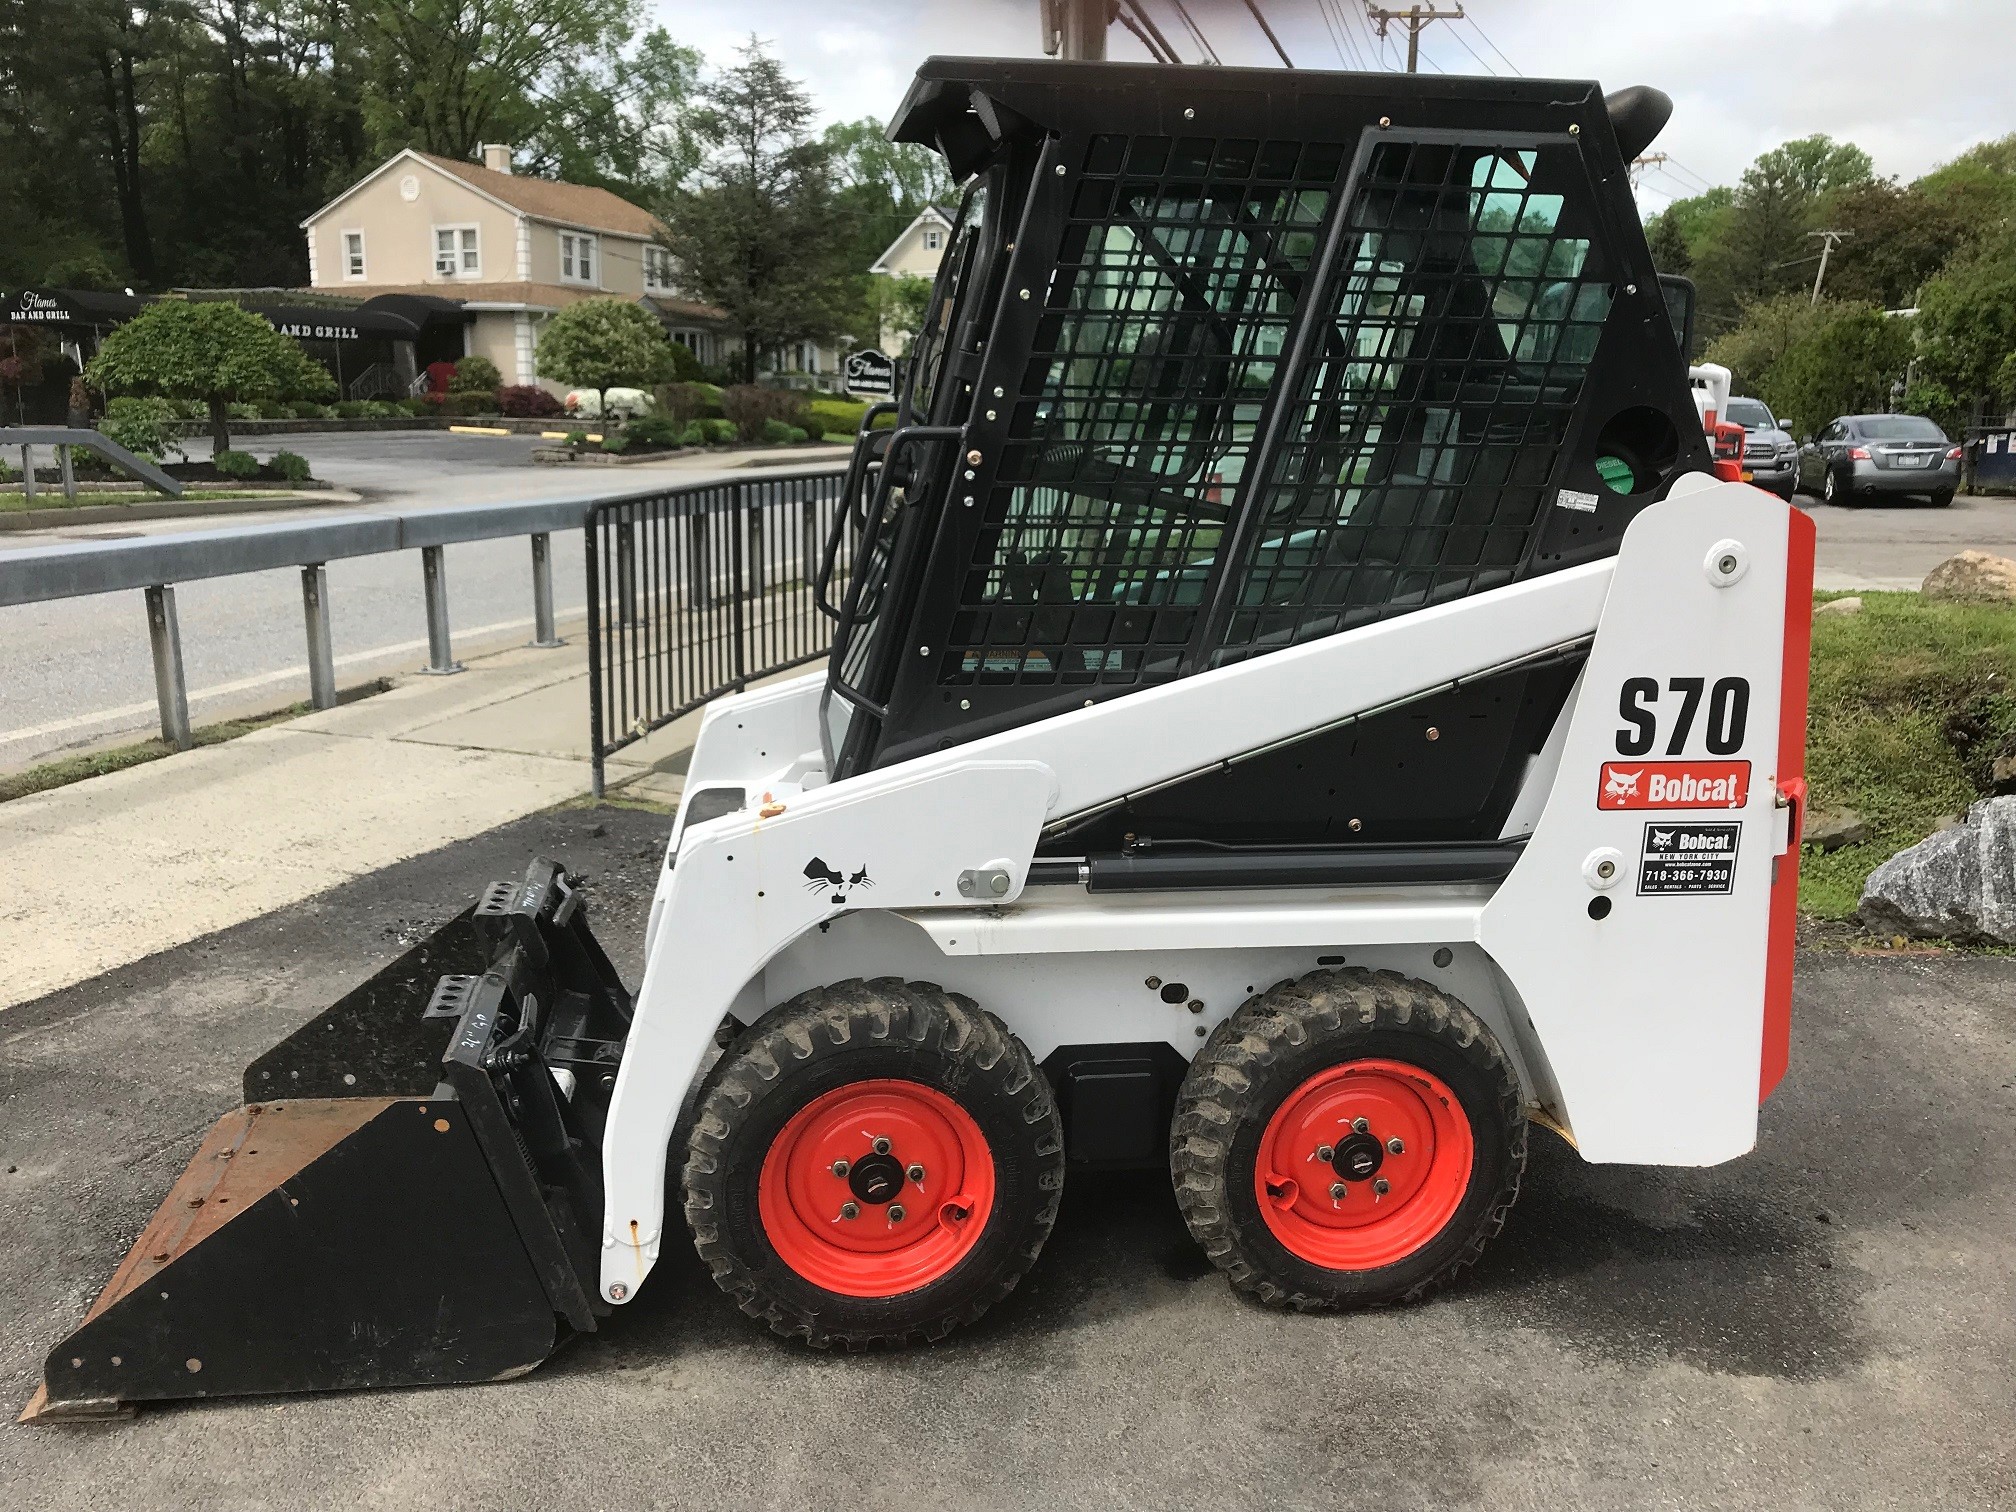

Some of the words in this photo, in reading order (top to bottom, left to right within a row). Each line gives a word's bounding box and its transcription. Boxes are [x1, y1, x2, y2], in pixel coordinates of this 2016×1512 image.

[20, 291, 58, 310] Flames
[10, 311, 26, 320] BAR
[28, 310, 44, 320] AND
[45, 310, 70, 320] GRILL
[280, 323, 312, 337] AND
[315, 325, 359, 339] GRILL
[1615, 676, 1751, 757] S70
[1648, 773, 1738, 803] Bobcat
[1679, 833, 1730, 850] Bobcat
[1645, 869, 1728, 881] 718-366-7930
